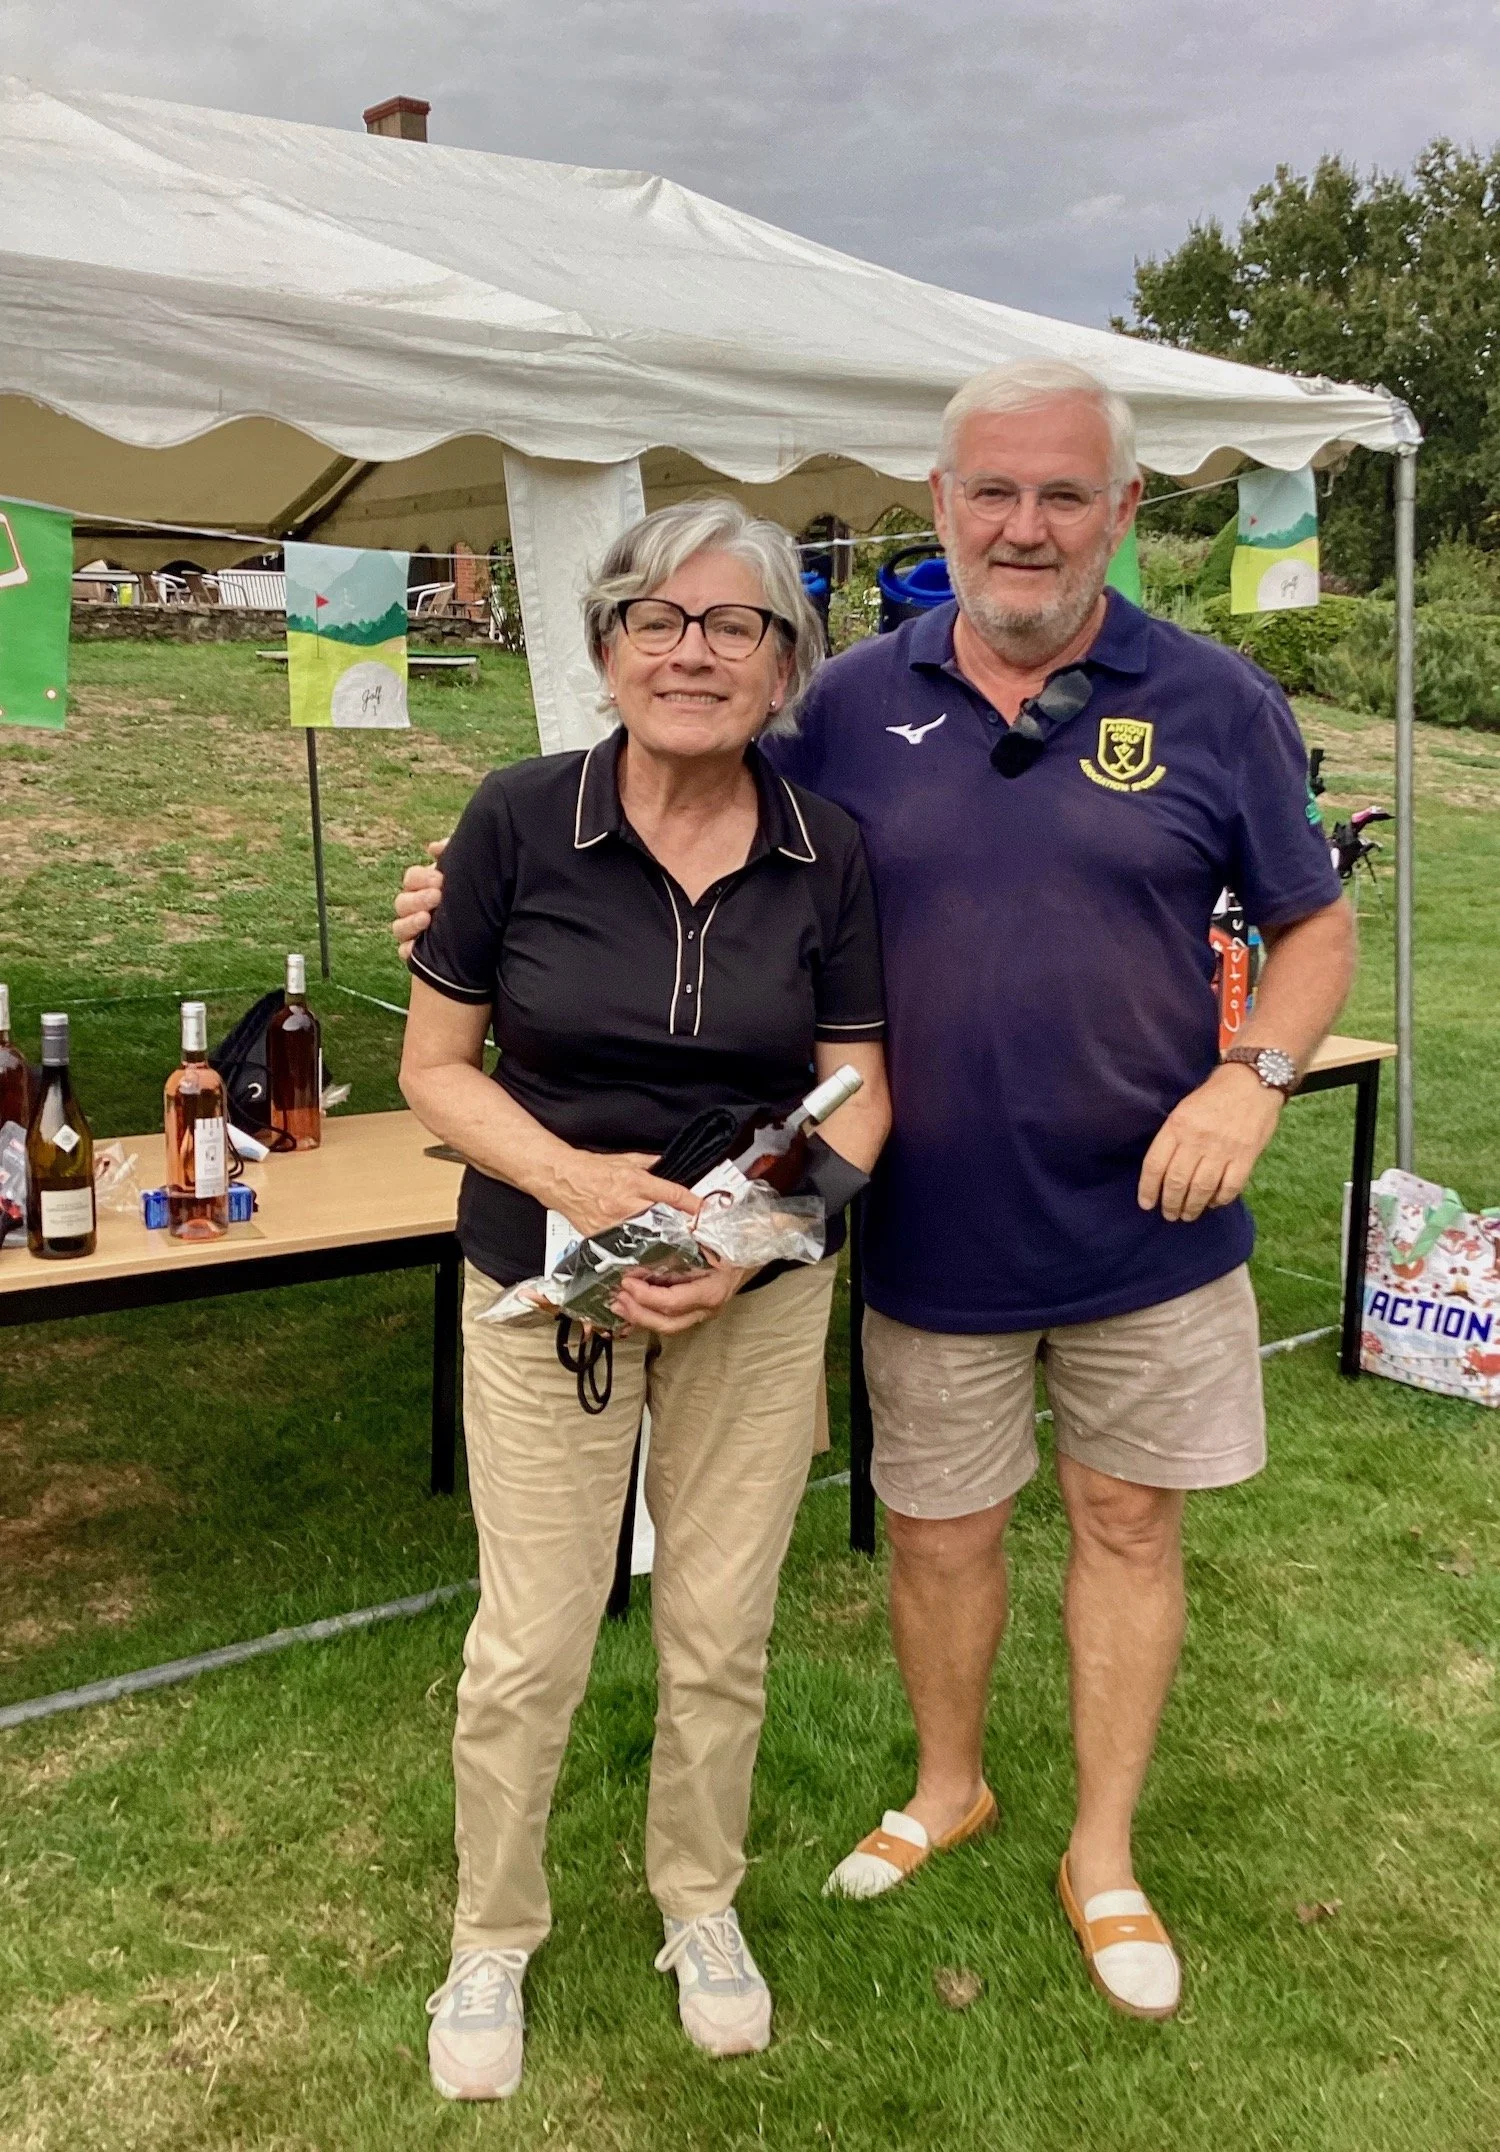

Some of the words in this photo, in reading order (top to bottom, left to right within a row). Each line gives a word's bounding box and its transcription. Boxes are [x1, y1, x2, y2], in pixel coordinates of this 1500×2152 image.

[1106, 724, 1145, 737] ANJOU
[1110, 732, 1141, 745] GOLF
[1368, 1290, 1493, 1342] ACTION
